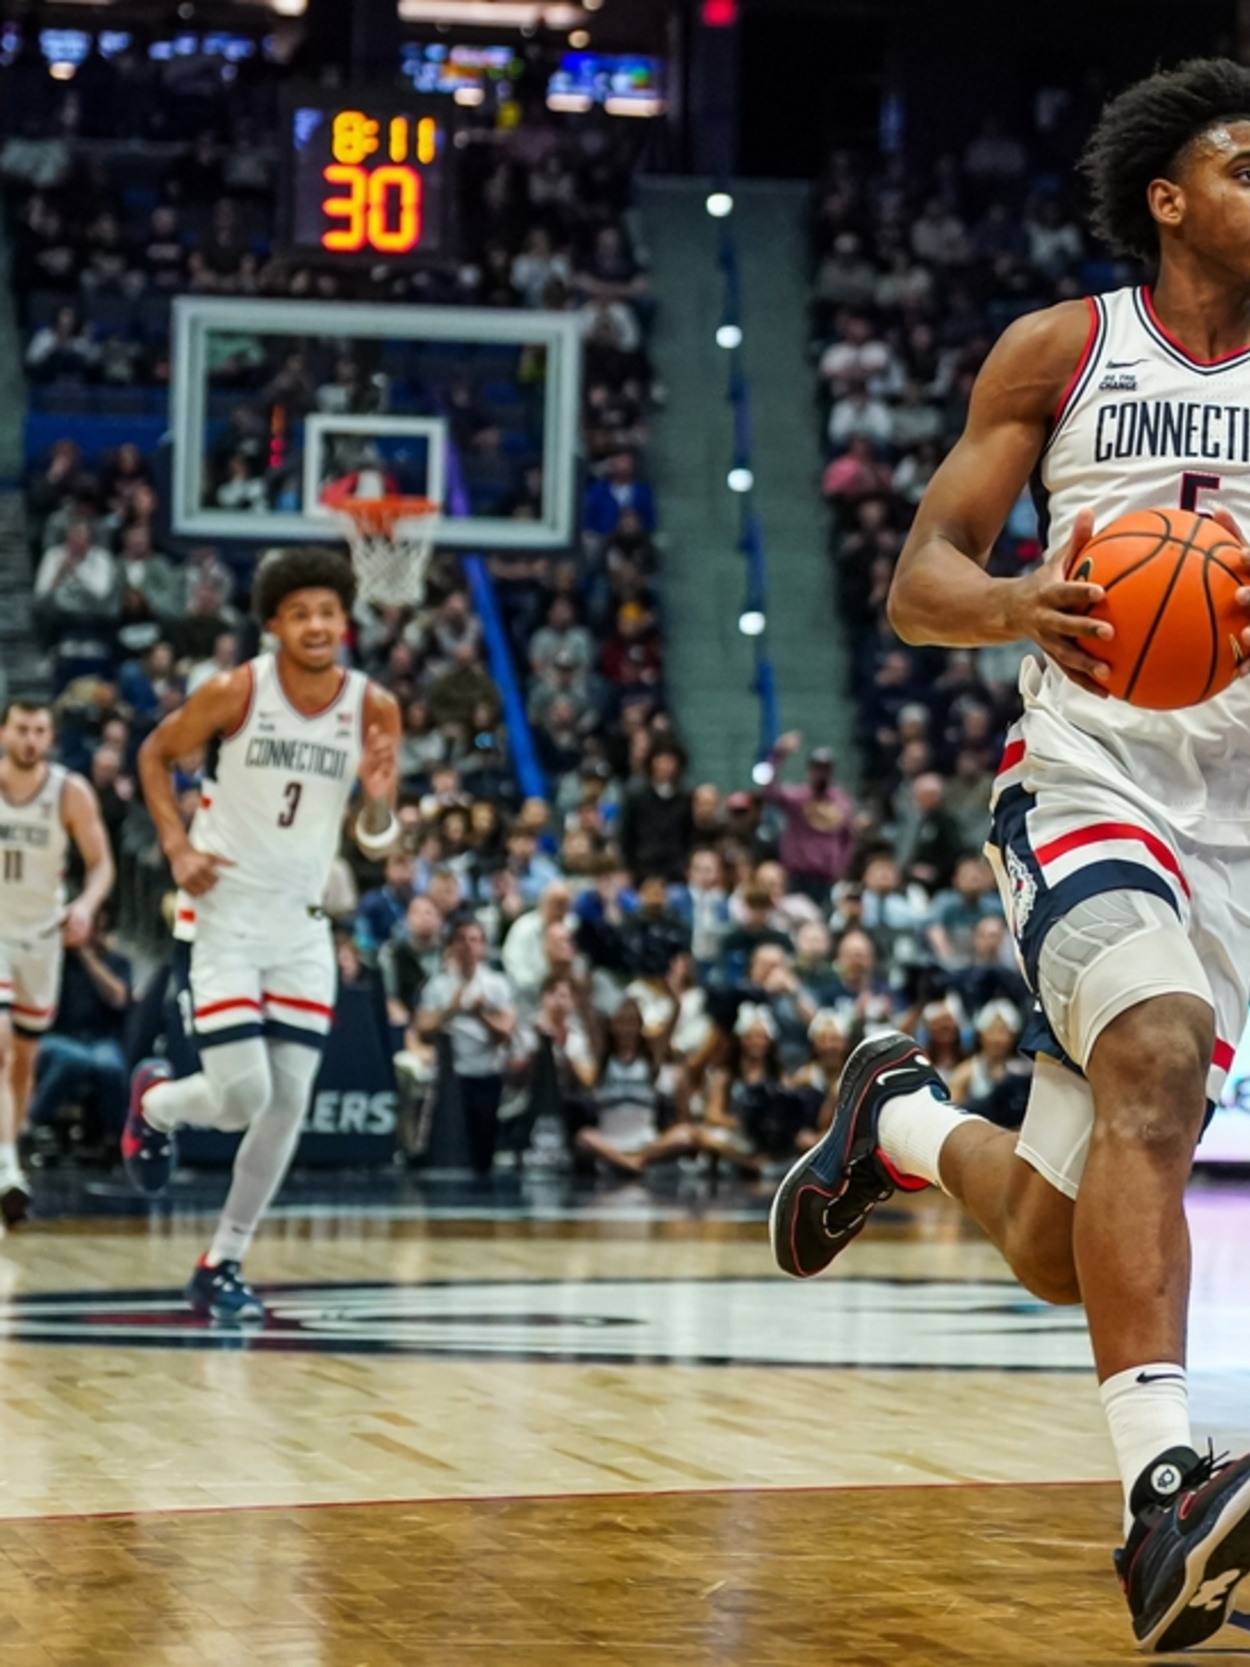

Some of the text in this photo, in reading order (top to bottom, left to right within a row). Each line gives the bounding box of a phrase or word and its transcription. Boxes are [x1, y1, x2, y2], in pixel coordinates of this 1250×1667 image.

[332, 109, 437, 165] 8:11
[320, 163, 423, 253] 30
[1098, 380, 1138, 392] CHANGE
[244, 737, 348, 780] CONNECTICUT
[277, 781, 303, 828] 3
[3, 849, 23, 882] 11
[302, 1090, 399, 1135] ERS
